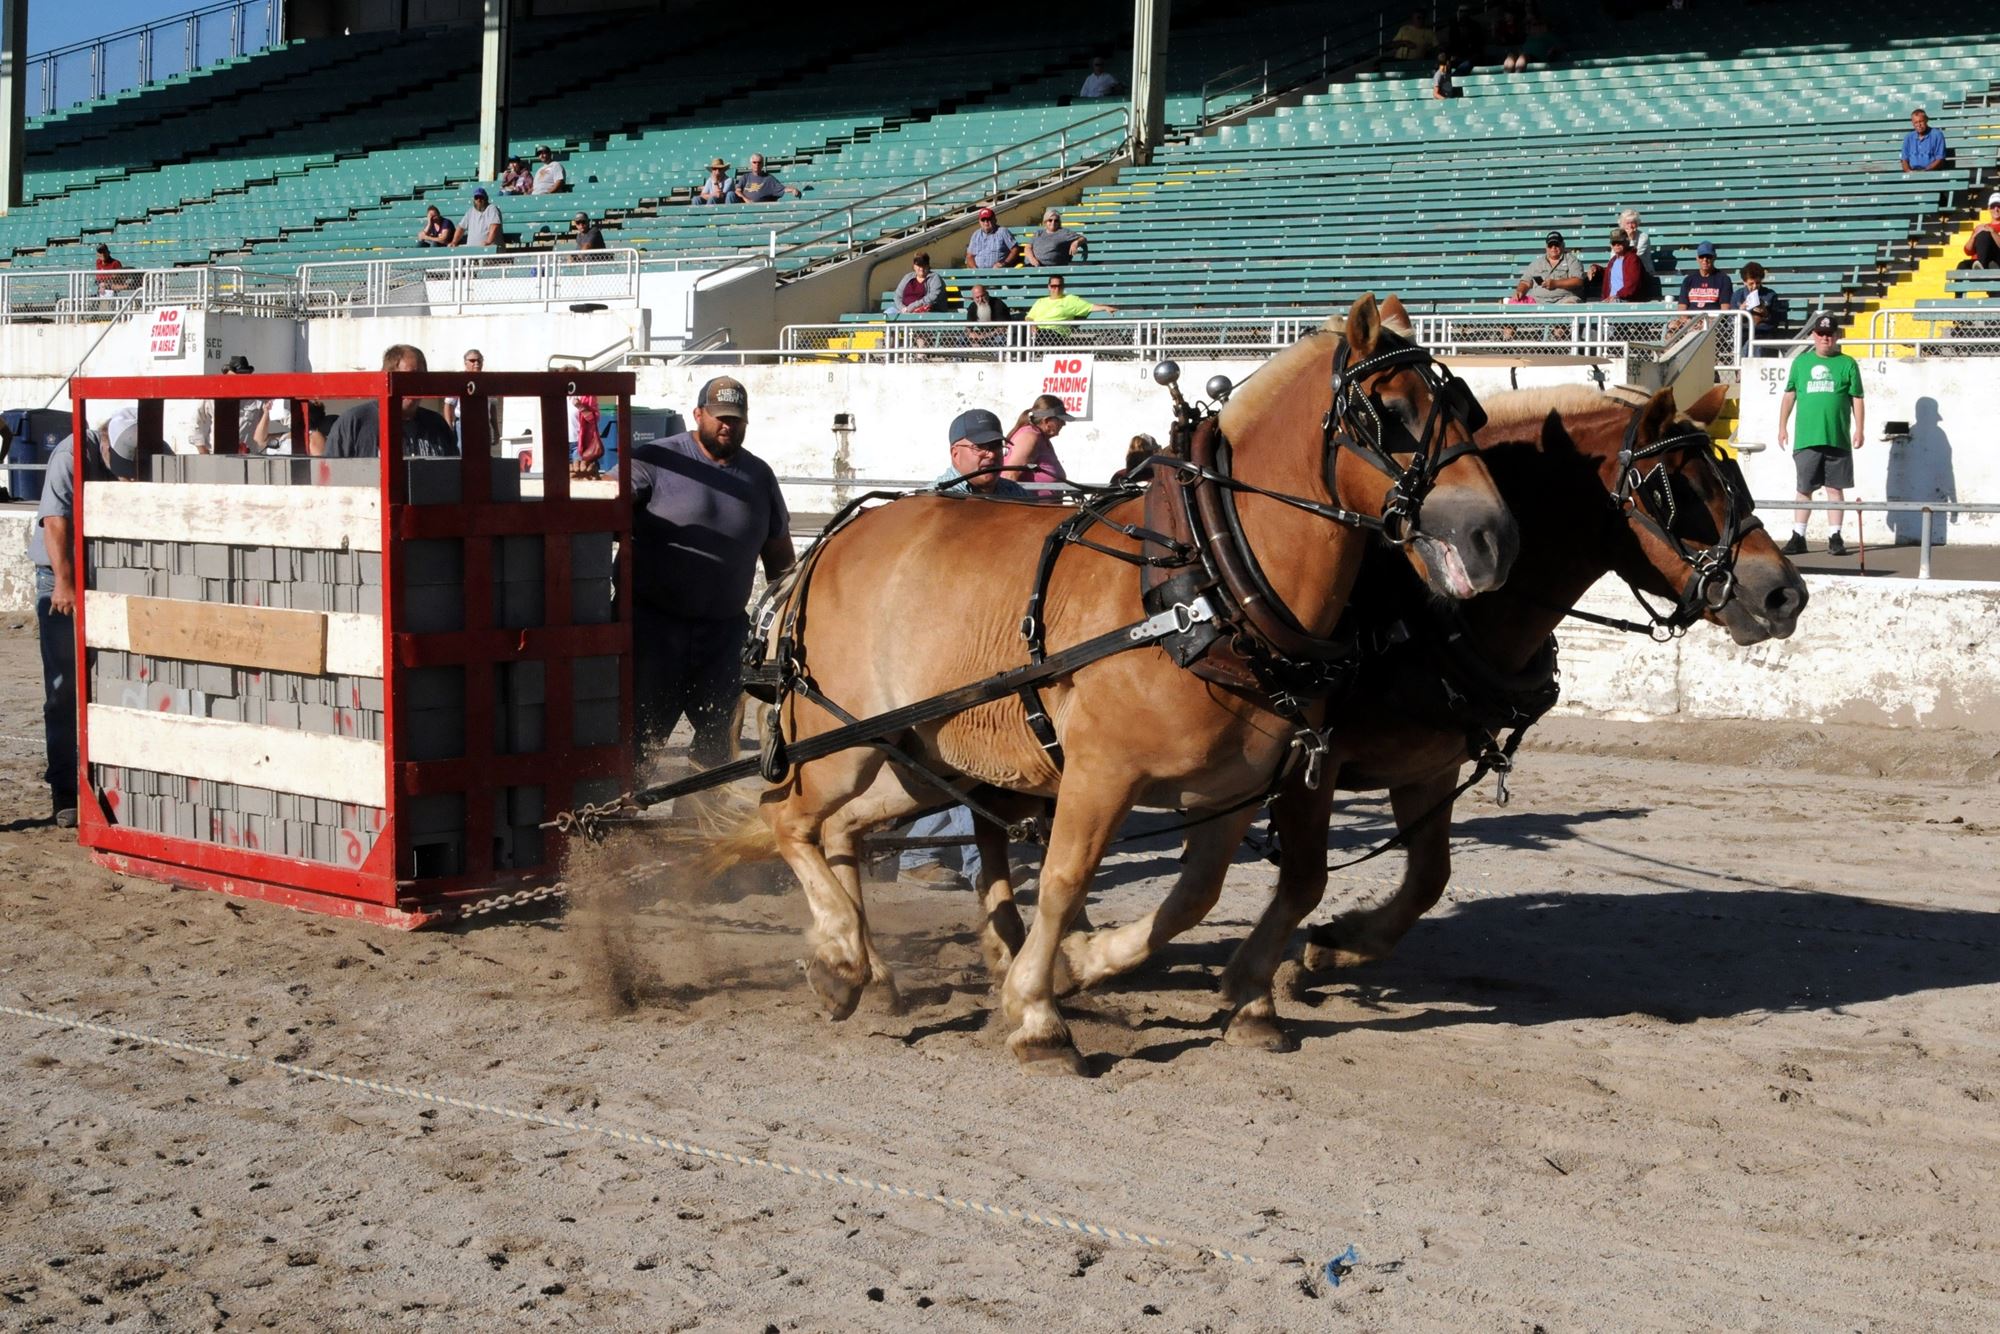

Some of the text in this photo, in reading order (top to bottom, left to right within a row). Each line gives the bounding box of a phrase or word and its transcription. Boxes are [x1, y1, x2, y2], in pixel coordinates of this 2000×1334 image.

[159, 310, 178, 322] NO
[151, 323, 180, 337] STANDING
[150, 339, 176, 352] IN AISLE
[206, 338, 223, 348] SEC
[1053, 359, 1082, 374] NO
[1877, 361, 1887, 374] G
[687, 371, 693, 383] A
[828, 371, 834, 383] B
[977, 370, 984, 382] C
[1140, 367, 1148, 380] D
[1587, 369, 1611, 382] SC
[1760, 368, 1786, 381] SEC
[1042, 377, 1088, 393] STANDING
[1769, 382, 1777, 395] 2
[1060, 396, 1083, 412] ISLE
